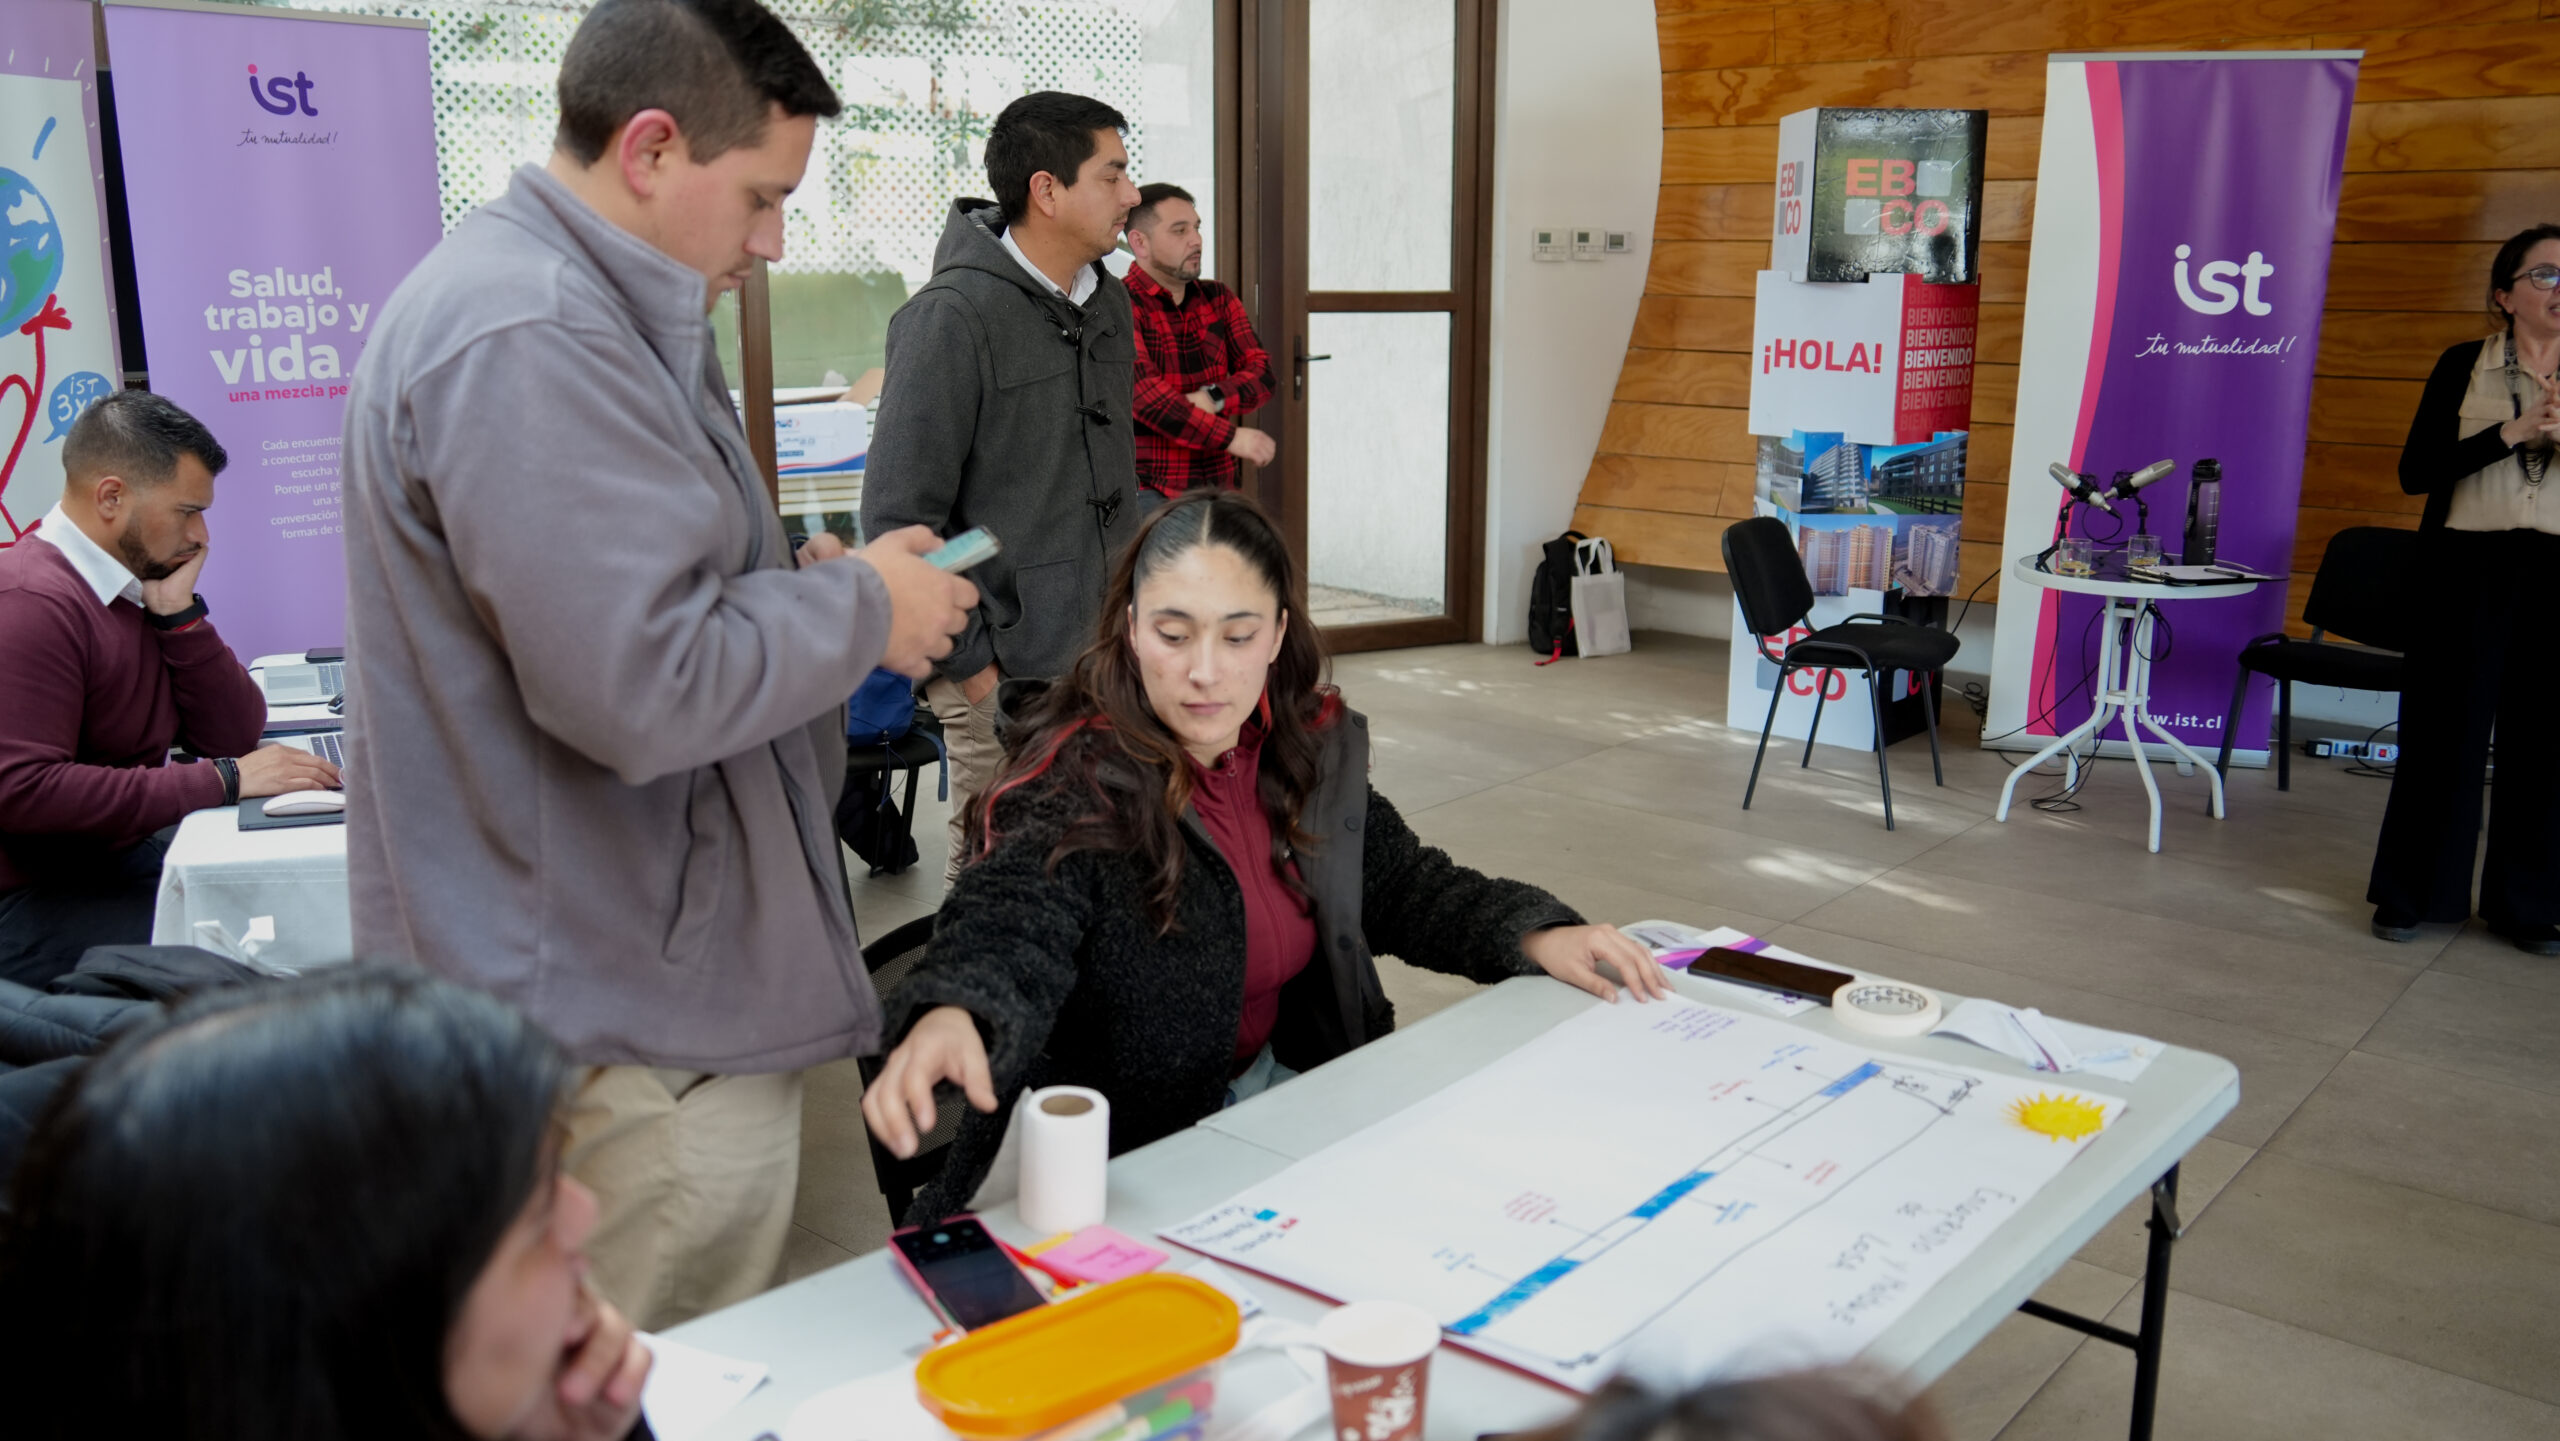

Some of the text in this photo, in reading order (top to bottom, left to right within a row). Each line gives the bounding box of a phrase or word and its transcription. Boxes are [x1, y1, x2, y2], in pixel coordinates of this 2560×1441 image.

[248, 64, 318, 116] ist
[1780, 162, 1795, 198] EB
[1845, 158, 1916, 197] EB
[1785, 199, 1801, 235] CO
[1881, 199, 1949, 237] CO
[228, 266, 343, 300] Salud,
[2174, 244, 2274, 316] ist
[204, 296, 370, 335] trabajo y
[1907, 306, 1976, 326] BIENVENIDO
[1906, 327, 1974, 348] BIENVENIDO
[2135, 332, 2297, 363] tu mutualidad!
[1763, 338, 1882, 374] ¡HOLA!
[1905, 347, 1972, 369] BIENVENIDO
[1903, 368, 1970, 390] BIENVENIDO
[228, 384, 350, 402] una mezcla pe
[1902, 388, 1969, 411] BIENVENIDO
[262, 436, 343, 451] Cada encuentro
[262, 458, 268, 466] a
[270, 453, 316, 465] conectar
[318, 451, 337, 461] con
[291, 466, 333, 478] escucha
[274, 483, 312, 495] Porque
[314, 482, 328, 491] un
[312, 496, 332, 506] una
[270, 510, 338, 525] conversación
[282, 528, 318, 539] formas
[320, 524, 333, 534] de
[1787, 666, 1847, 701] CO
